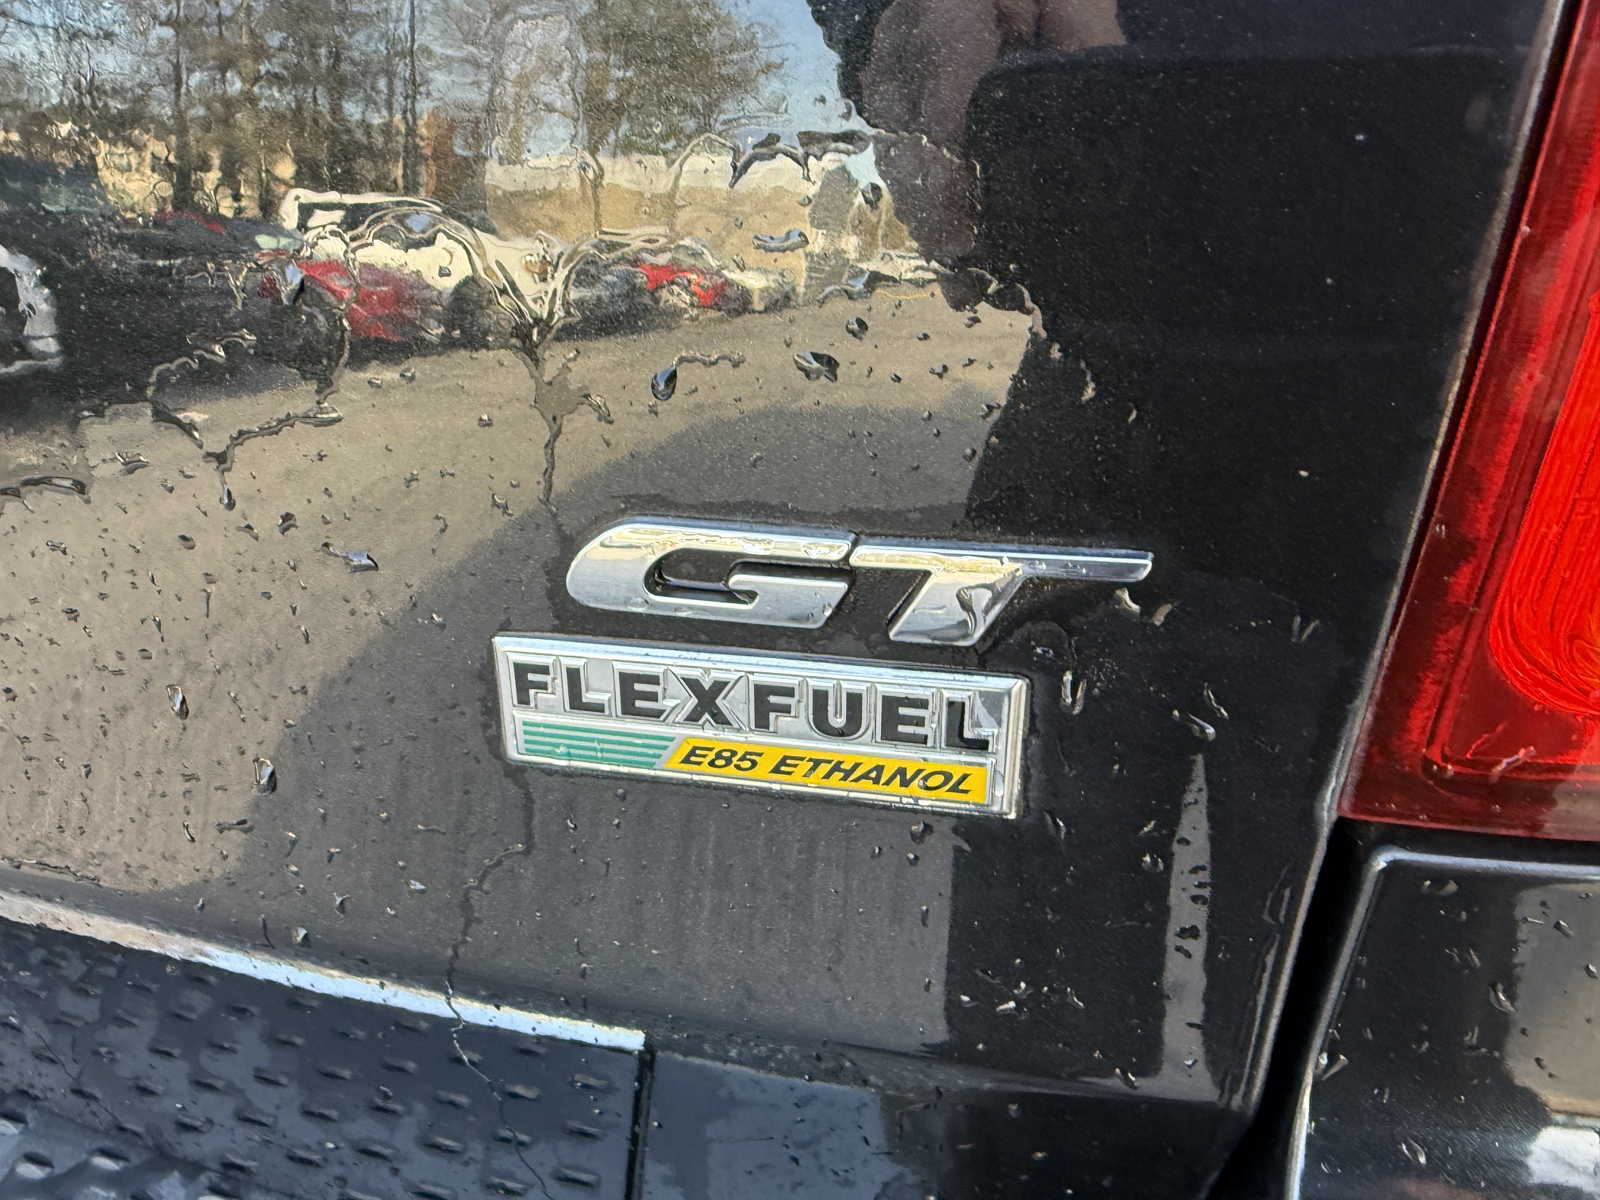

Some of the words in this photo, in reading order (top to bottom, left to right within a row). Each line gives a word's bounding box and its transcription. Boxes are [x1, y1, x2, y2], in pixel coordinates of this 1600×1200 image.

[566, 518, 1153, 646] GT
[679, 745, 763, 772] E85
[769, 755, 973, 794] ETHANOL
